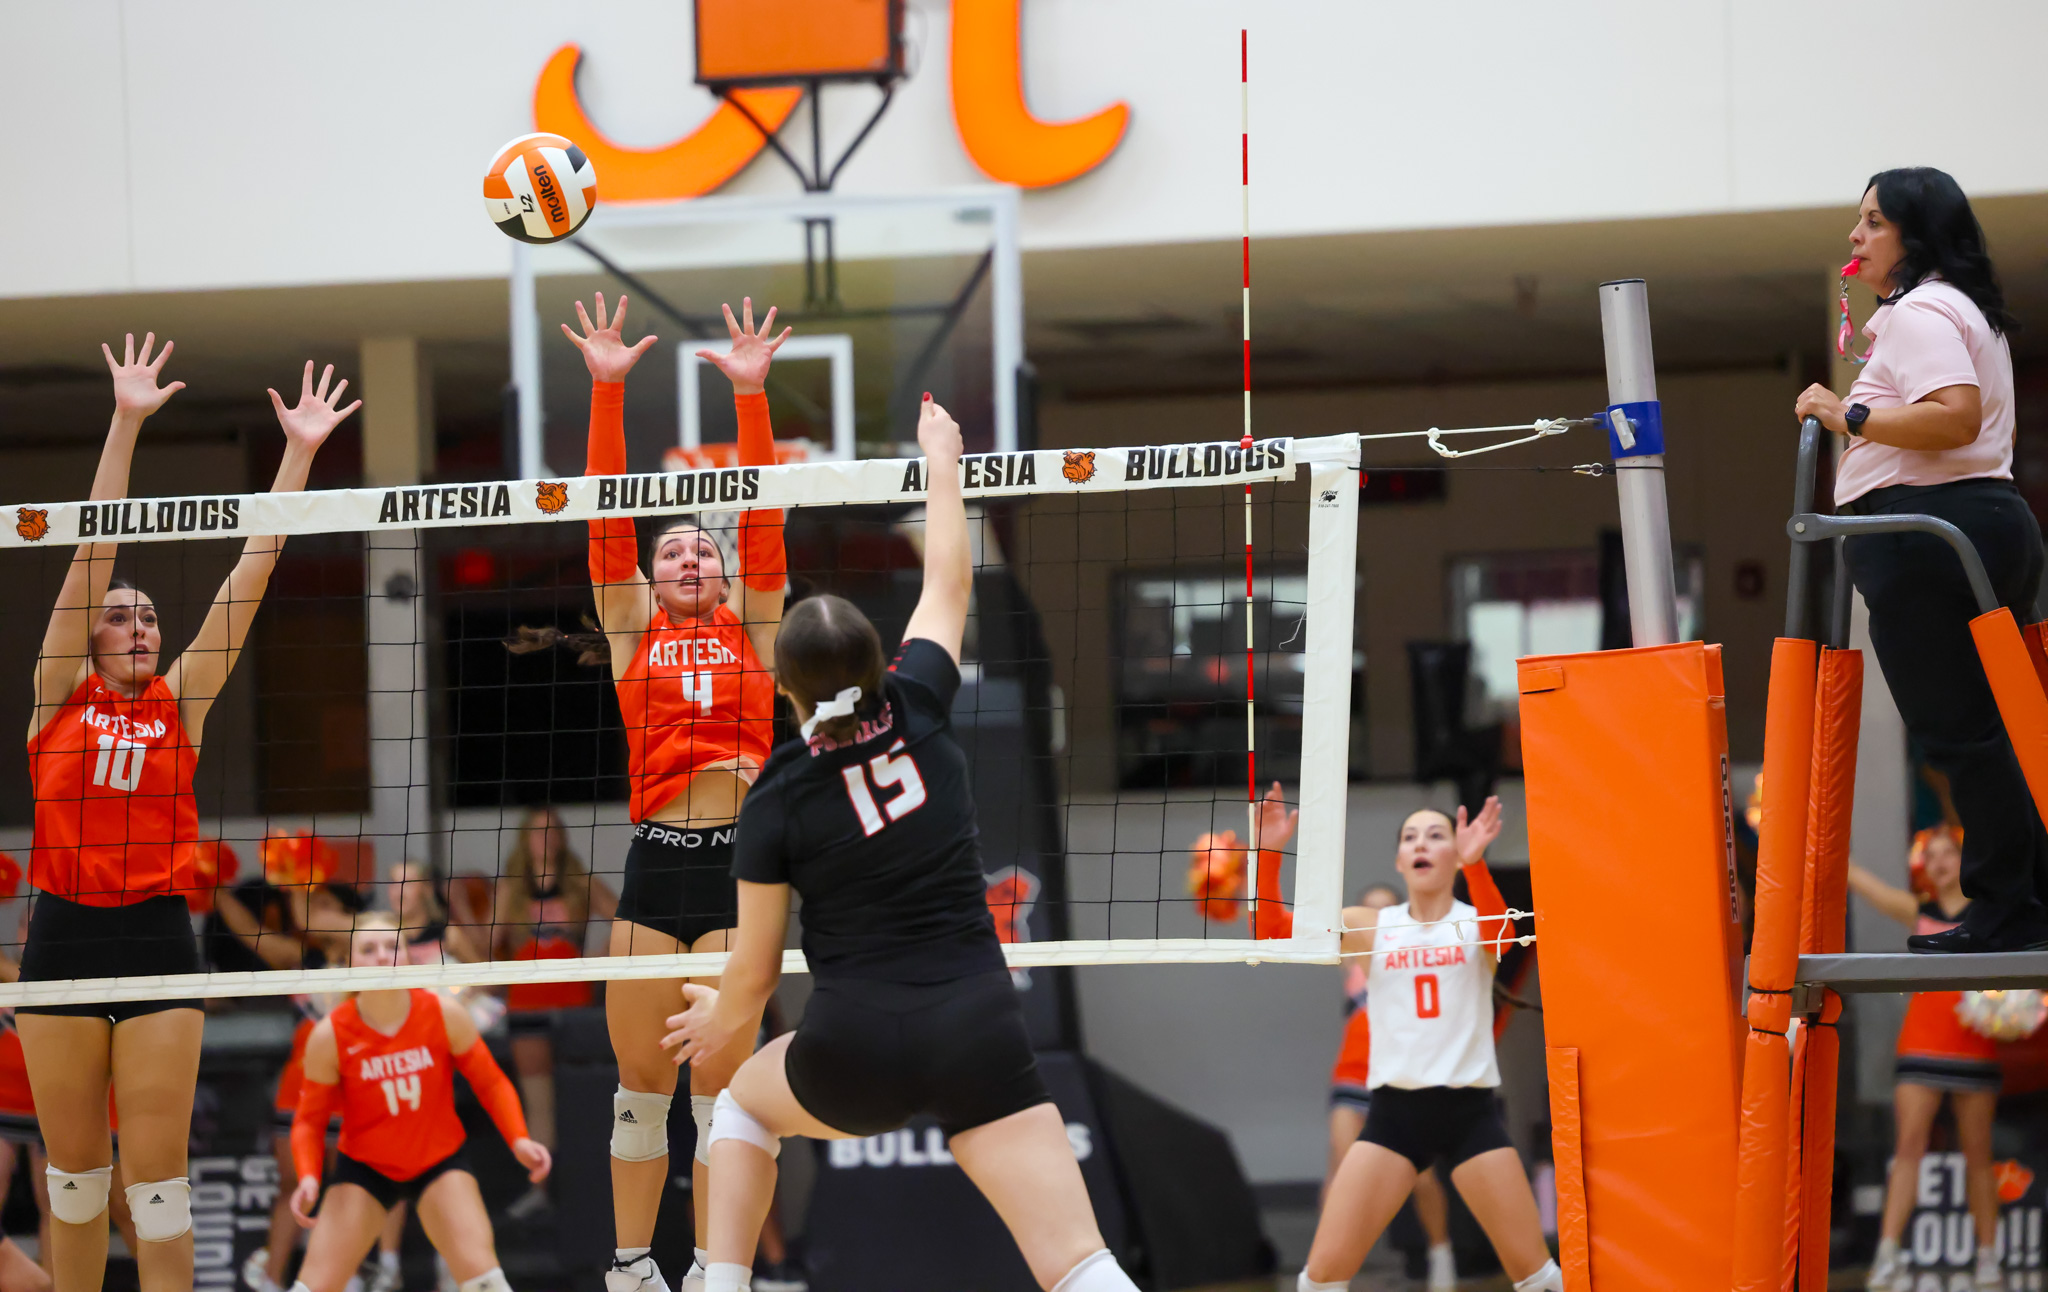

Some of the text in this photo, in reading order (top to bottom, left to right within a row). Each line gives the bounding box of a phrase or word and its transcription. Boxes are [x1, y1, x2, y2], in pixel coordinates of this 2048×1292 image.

[520, 193, 535, 213] L2
[533, 165, 565, 223] molten
[900, 438, 1287, 492] AESIA BULLDOGS
[78, 498, 240, 538] BULLDOGS
[378, 468, 760, 523] ARTESIA BULLDOGS
[681, 670, 713, 717] 4
[80, 705, 167, 739] ARTESIA
[92, 733, 147, 792] 10
[840, 736, 928, 838] 15
[647, 826, 703, 848] PRO
[1384, 945, 1467, 971] ARTESIA
[1414, 973, 1440, 1019] 0
[361, 1045, 434, 1081] ARTESIA
[381, 1074, 422, 1116] 14
[828, 1121, 1094, 1169] BULLS
